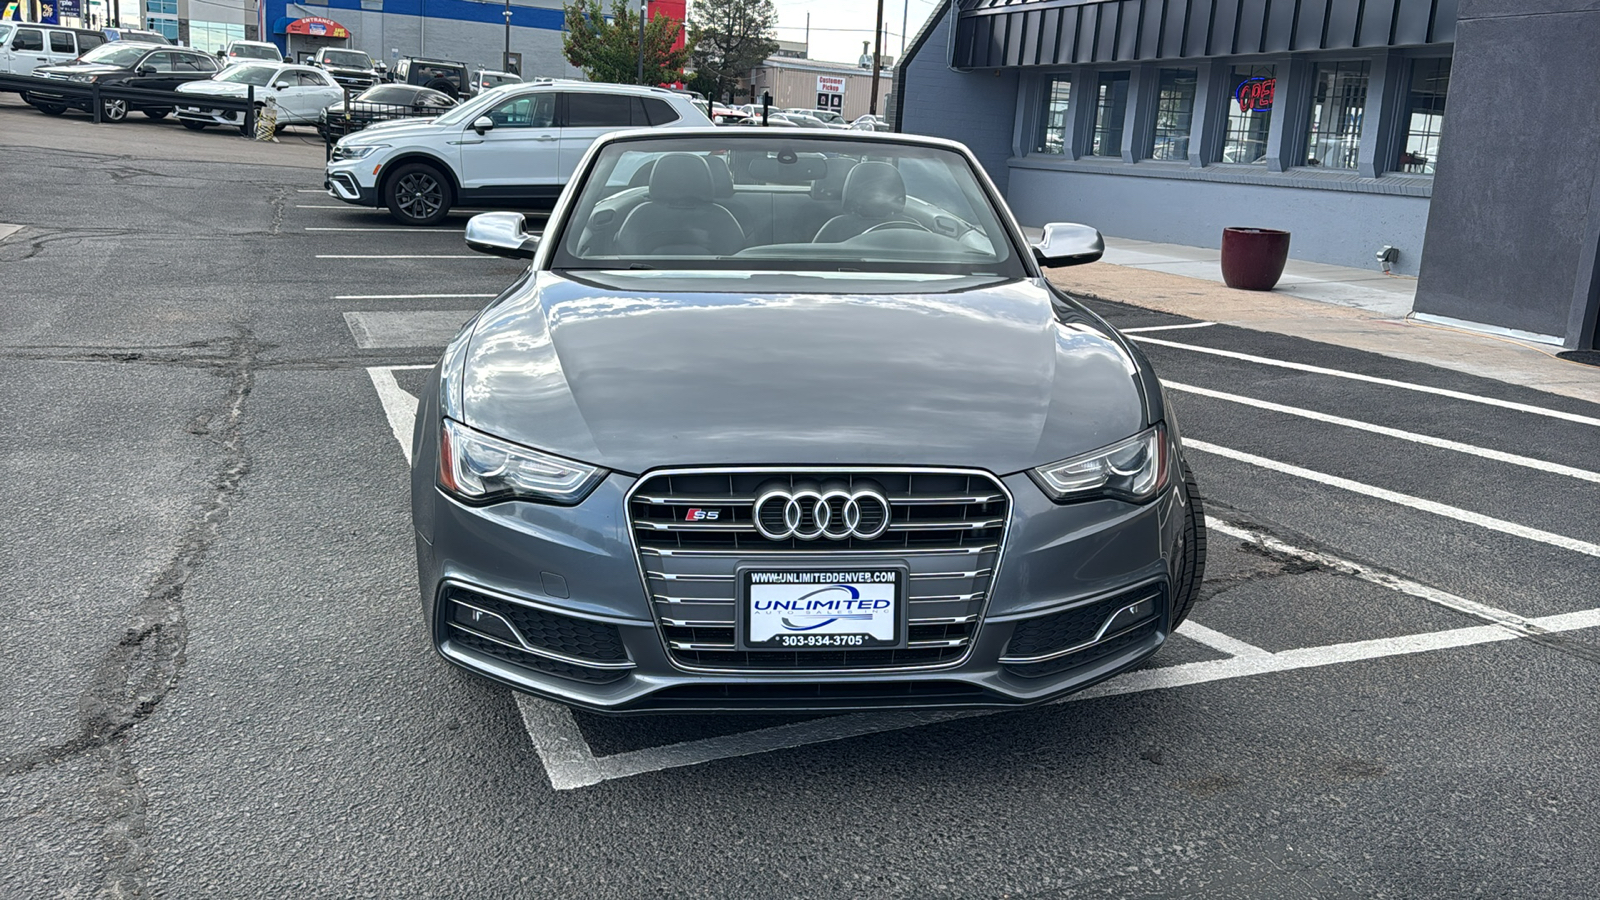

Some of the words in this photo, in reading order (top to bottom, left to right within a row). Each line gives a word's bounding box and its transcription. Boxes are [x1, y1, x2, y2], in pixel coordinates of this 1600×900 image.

[301, 17, 335, 26] ENTRANCE
[819, 76, 843, 84] Customer
[822, 84, 839, 92] Pickup
[693, 511, 719, 520] S5
[751, 572, 895, 583] WWWUNLIMITEDDENVER.COM
[754, 599, 891, 611] UNLIMITED
[782, 635, 863, 646] 303-934-3705
